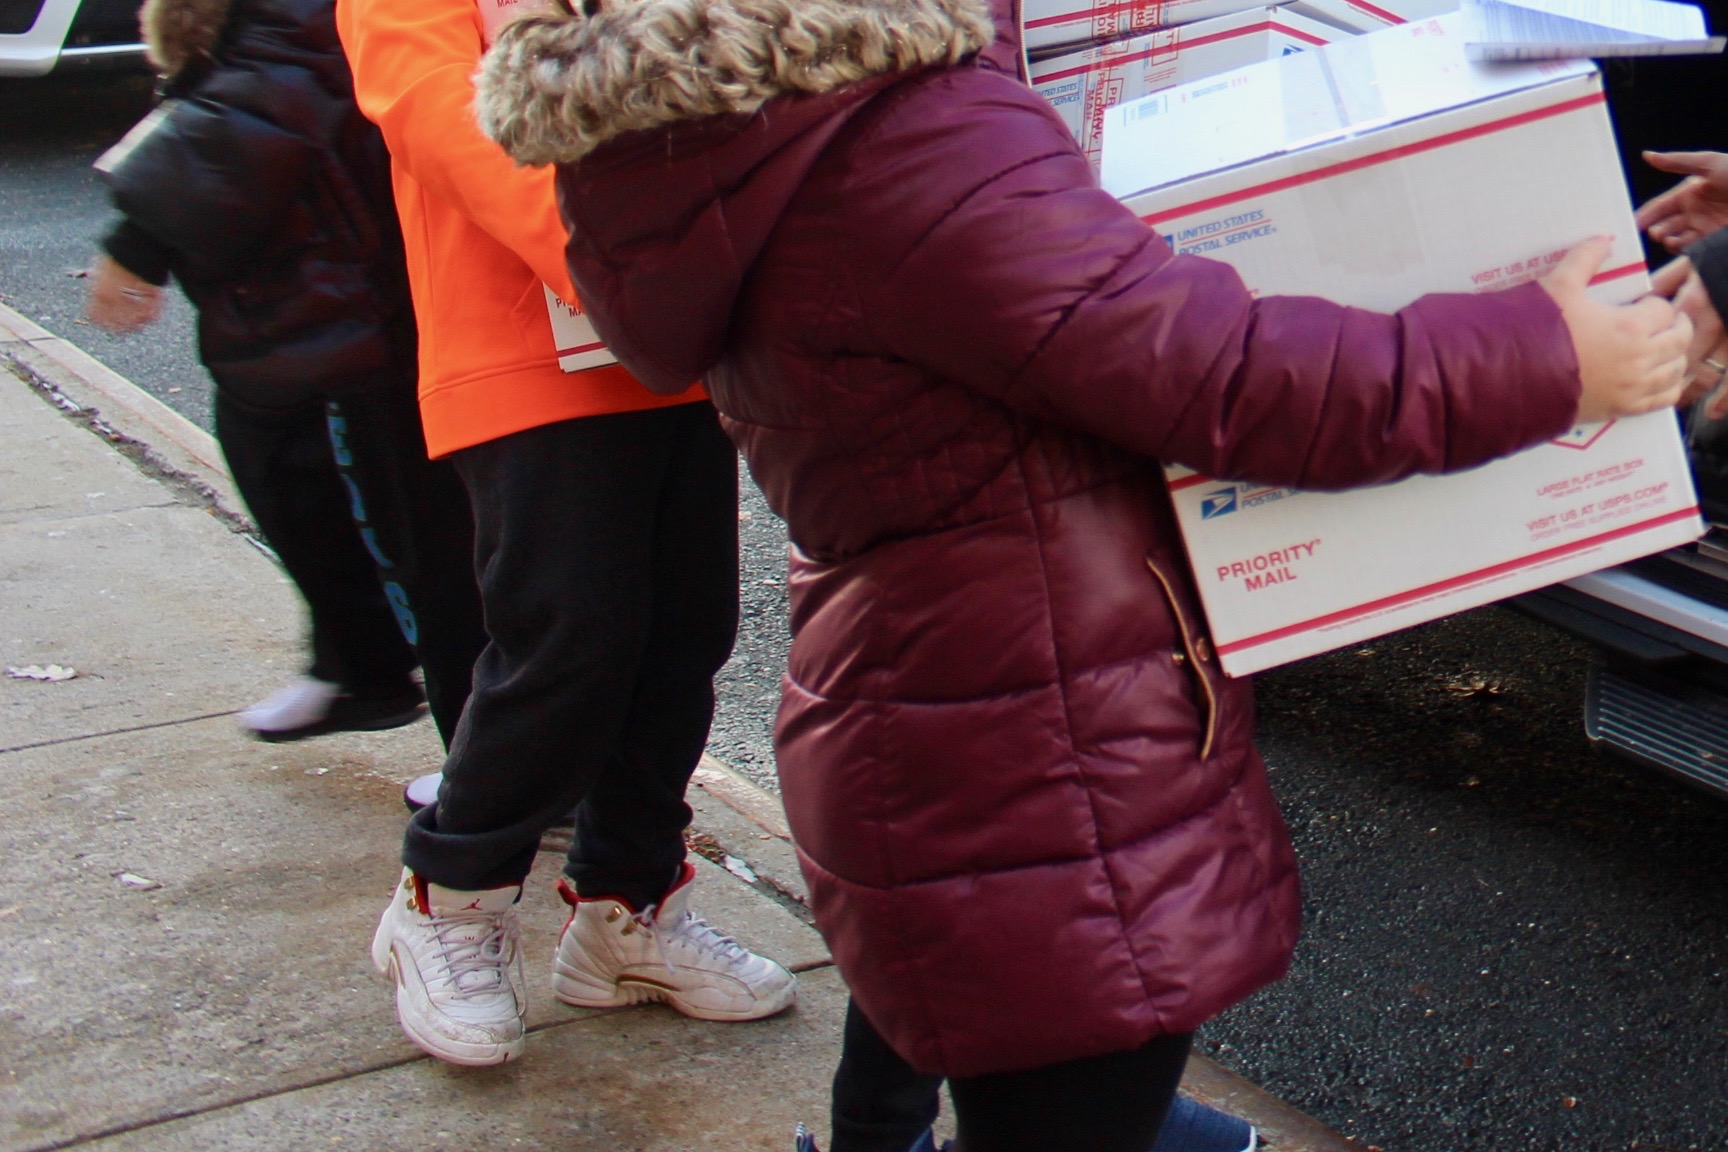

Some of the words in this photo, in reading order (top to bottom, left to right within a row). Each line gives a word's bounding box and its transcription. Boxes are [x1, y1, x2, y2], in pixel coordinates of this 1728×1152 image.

[1178, 221, 1221, 241] UNITED
[1223, 209, 1264, 229] STATES
[1225, 224, 1272, 246] SERVICE
[1217, 541, 1315, 582] PRIORITY
[1245, 567, 1298, 591] MAIL
